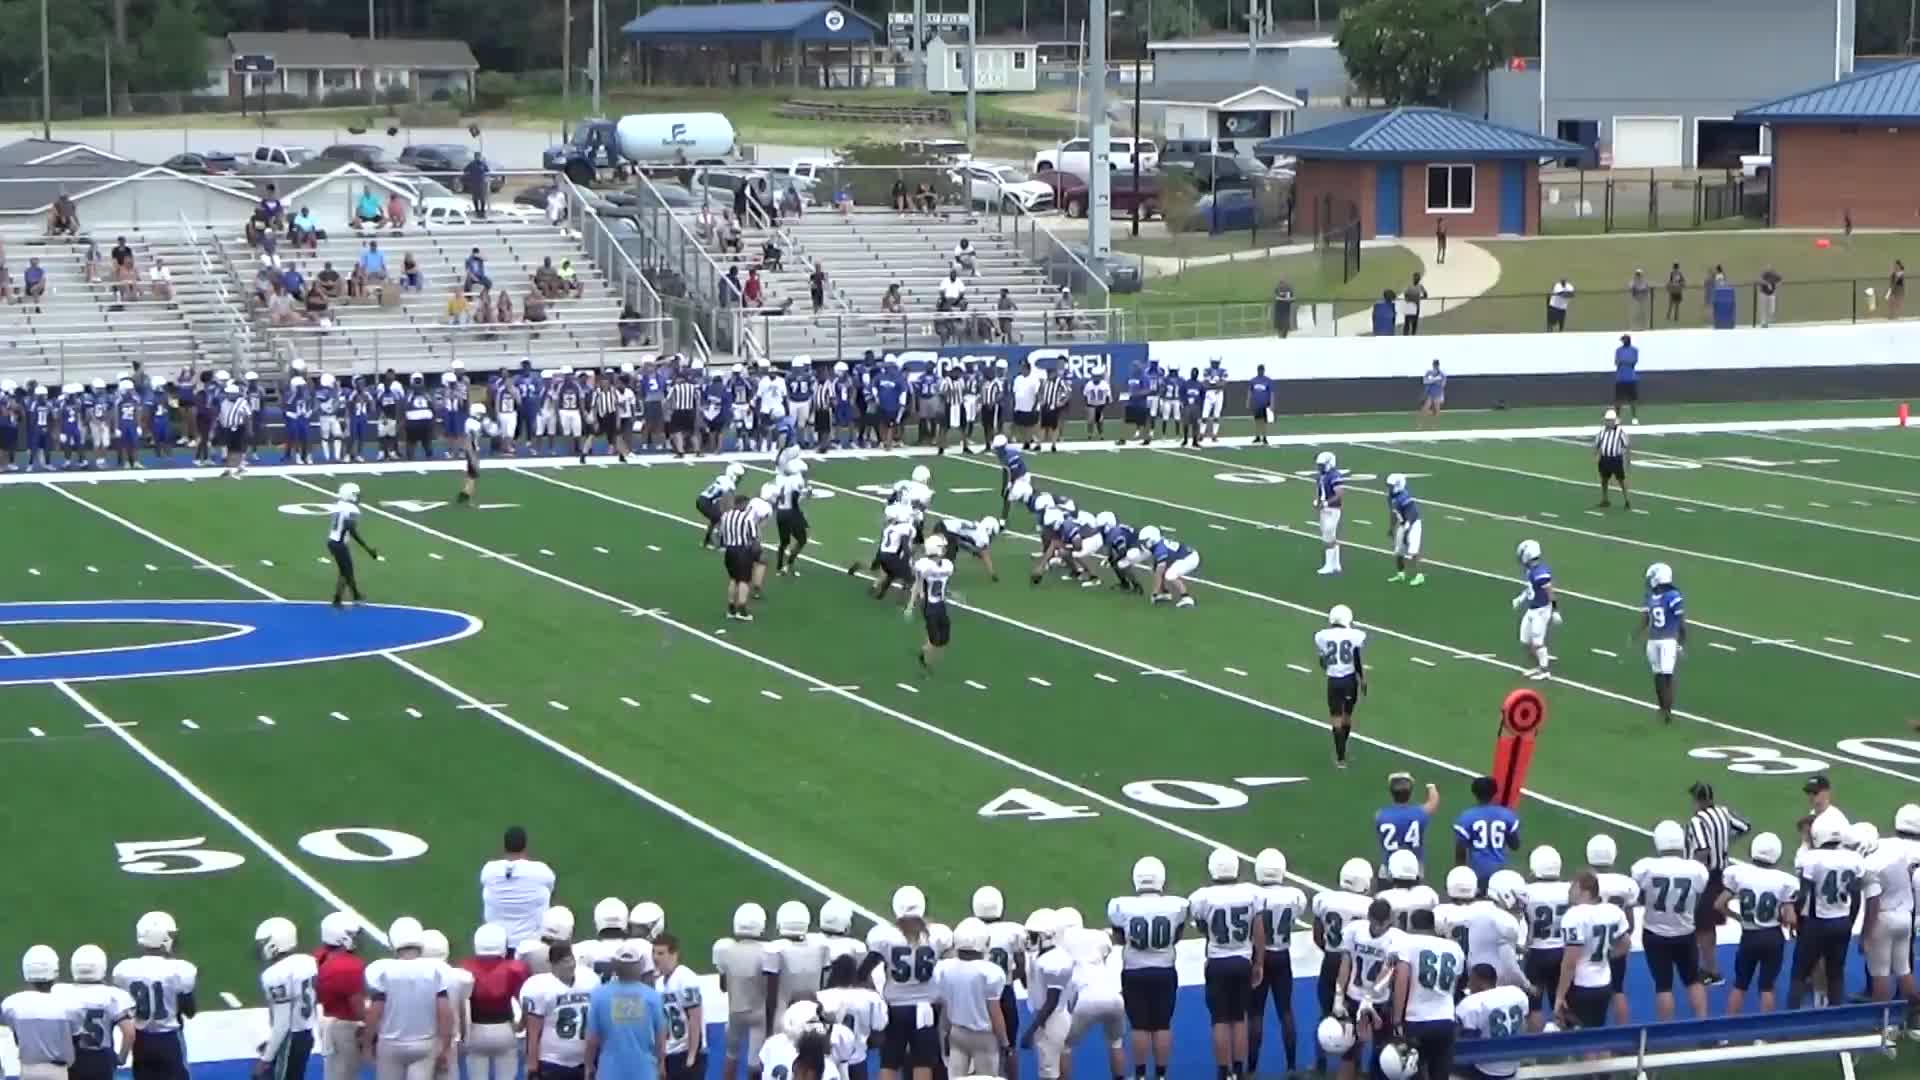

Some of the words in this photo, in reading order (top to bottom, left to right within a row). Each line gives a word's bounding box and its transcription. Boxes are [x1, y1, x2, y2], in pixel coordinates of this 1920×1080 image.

[1326, 640, 1352, 665] 26
[1380, 820, 1420, 851] 24
[1472, 819, 1506, 849] 36
[1652, 877, 1692, 913] 77
[1130, 915, 1171, 951] 90
[1212, 907, 1250, 945] 45
[891, 945, 936, 983] 56
[1419, 949, 1457, 991] 66
